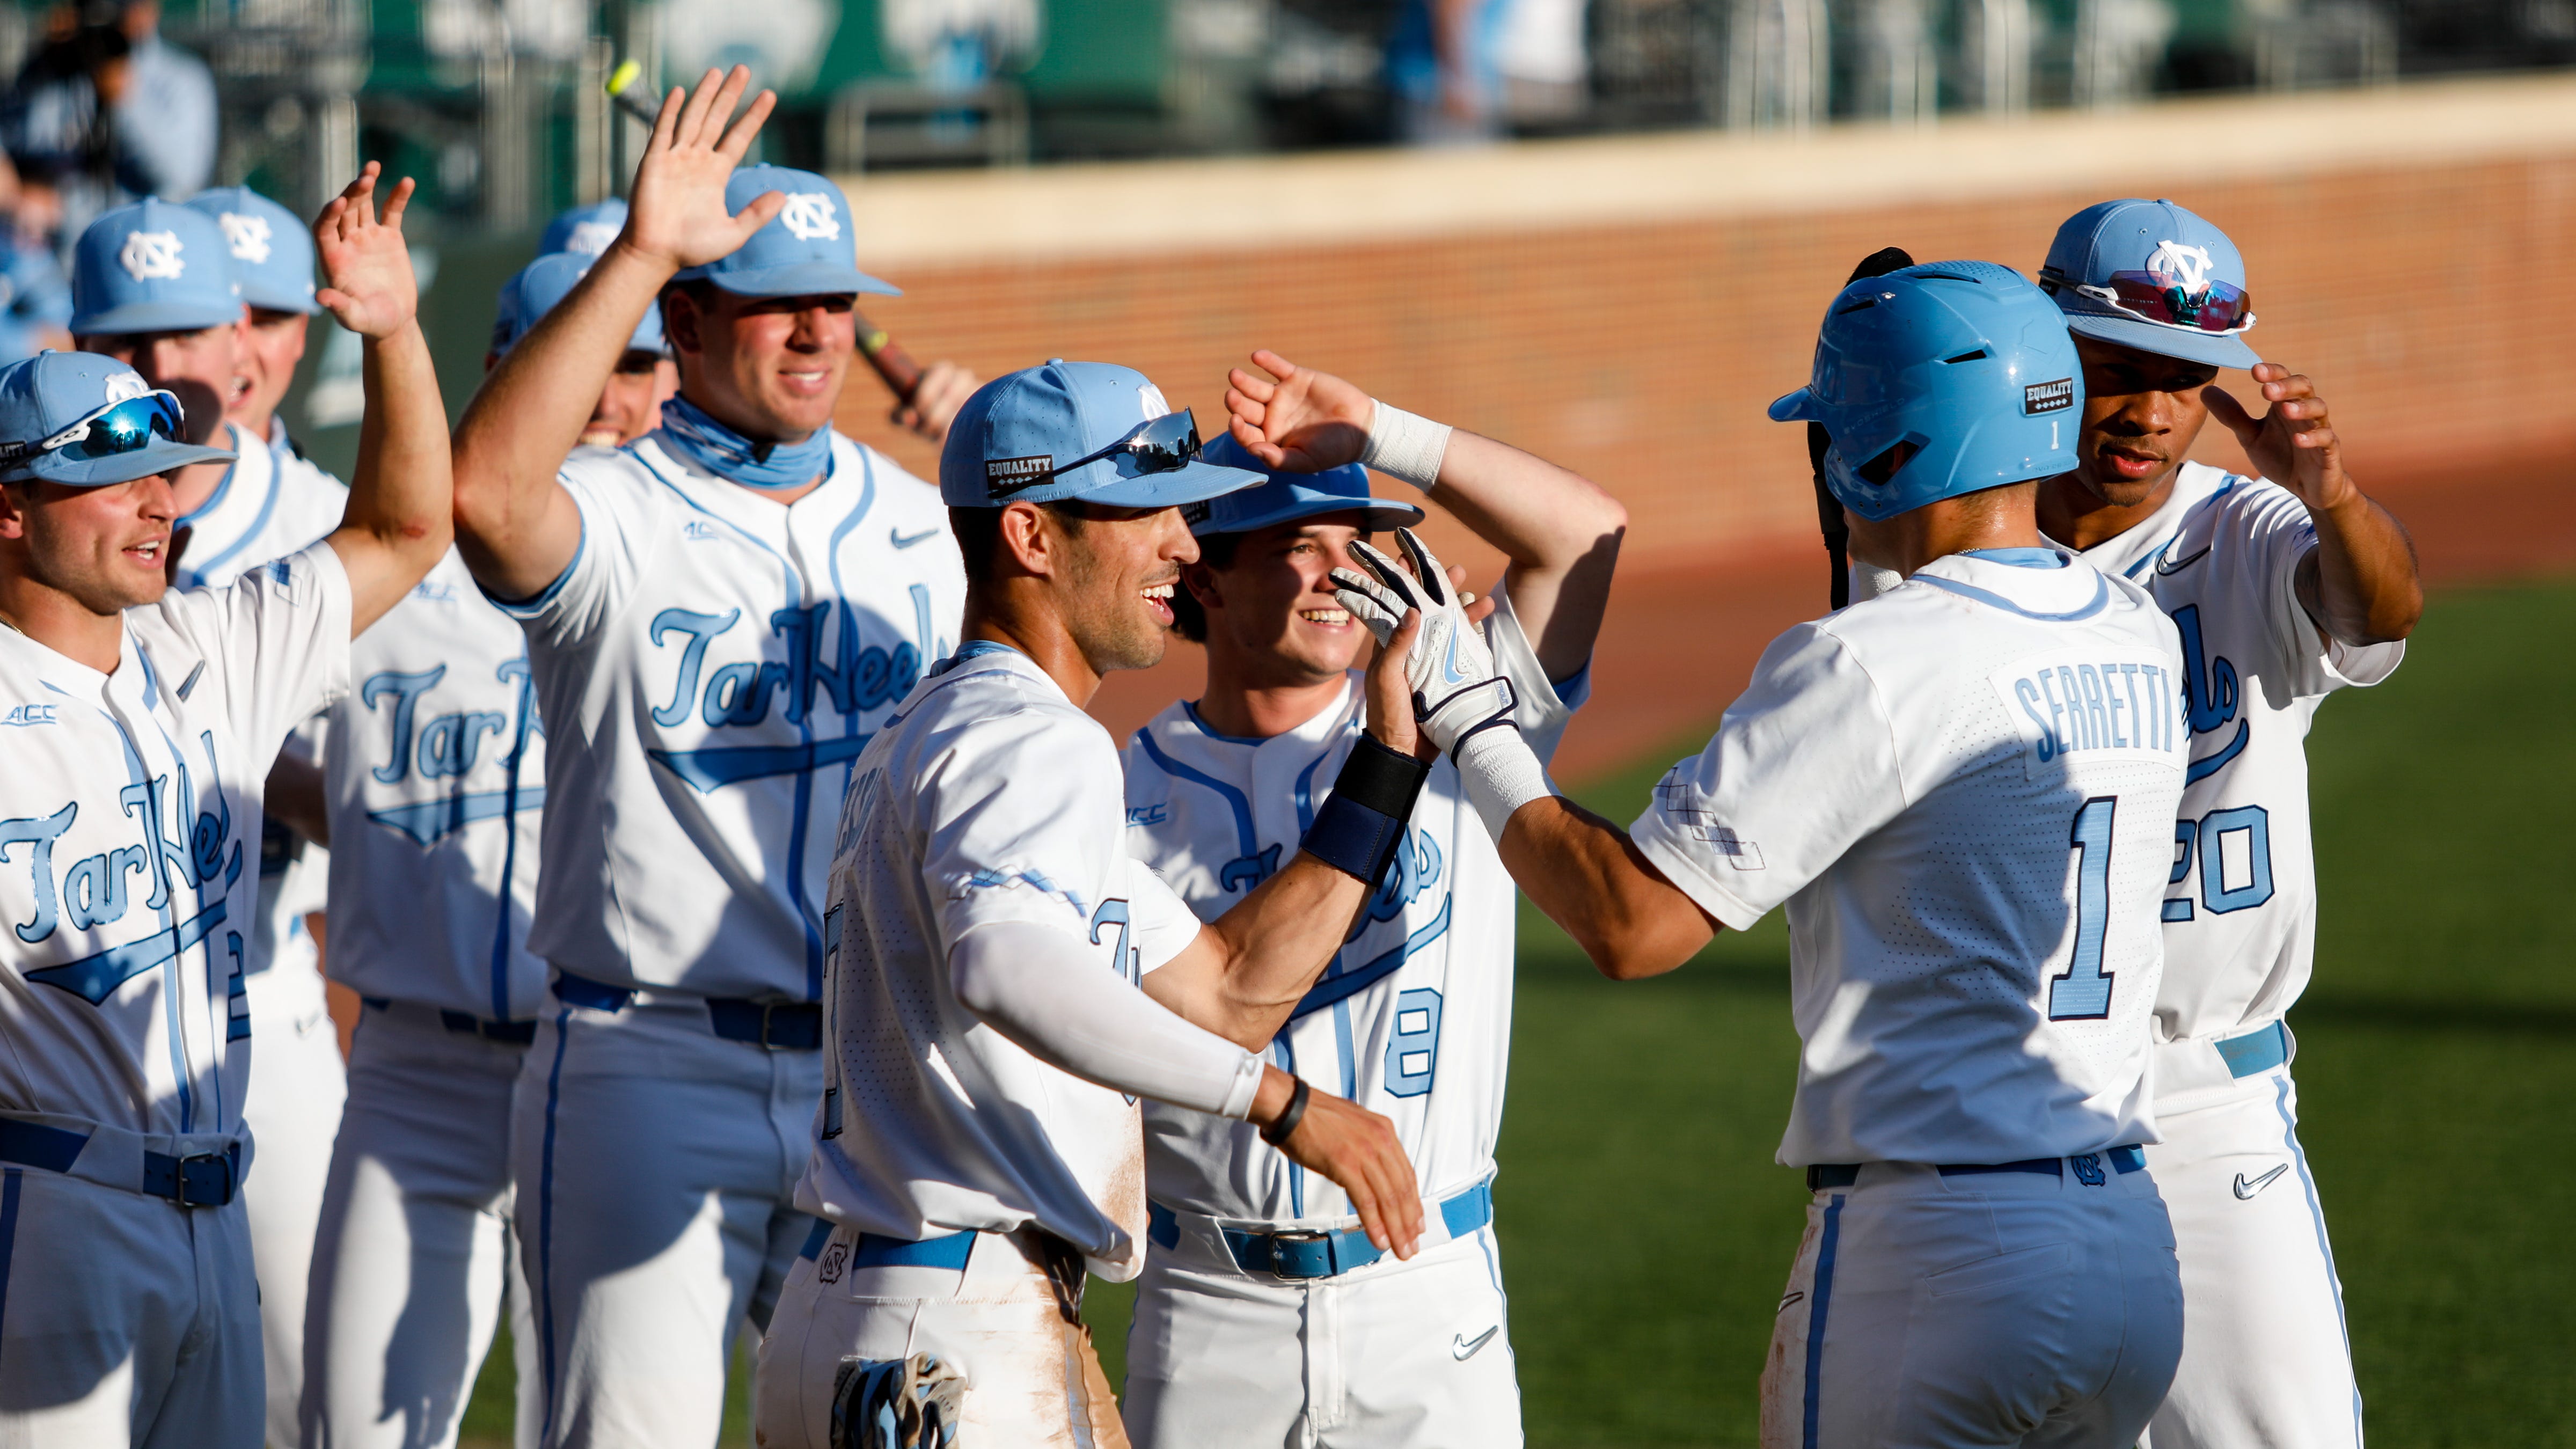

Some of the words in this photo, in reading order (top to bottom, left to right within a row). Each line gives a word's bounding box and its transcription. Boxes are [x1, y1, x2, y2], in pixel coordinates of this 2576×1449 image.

[2026, 380, 2072, 401] EQUALITY
[2051, 421, 2059, 450] 1
[988, 458, 1051, 477] EQUALITY
[5, 704, 60, 722] ACC
[2015, 663, 2172, 763] SERRETTI
[2048, 795, 2118, 1021] 1
[1384, 987, 1443, 1098] 8
